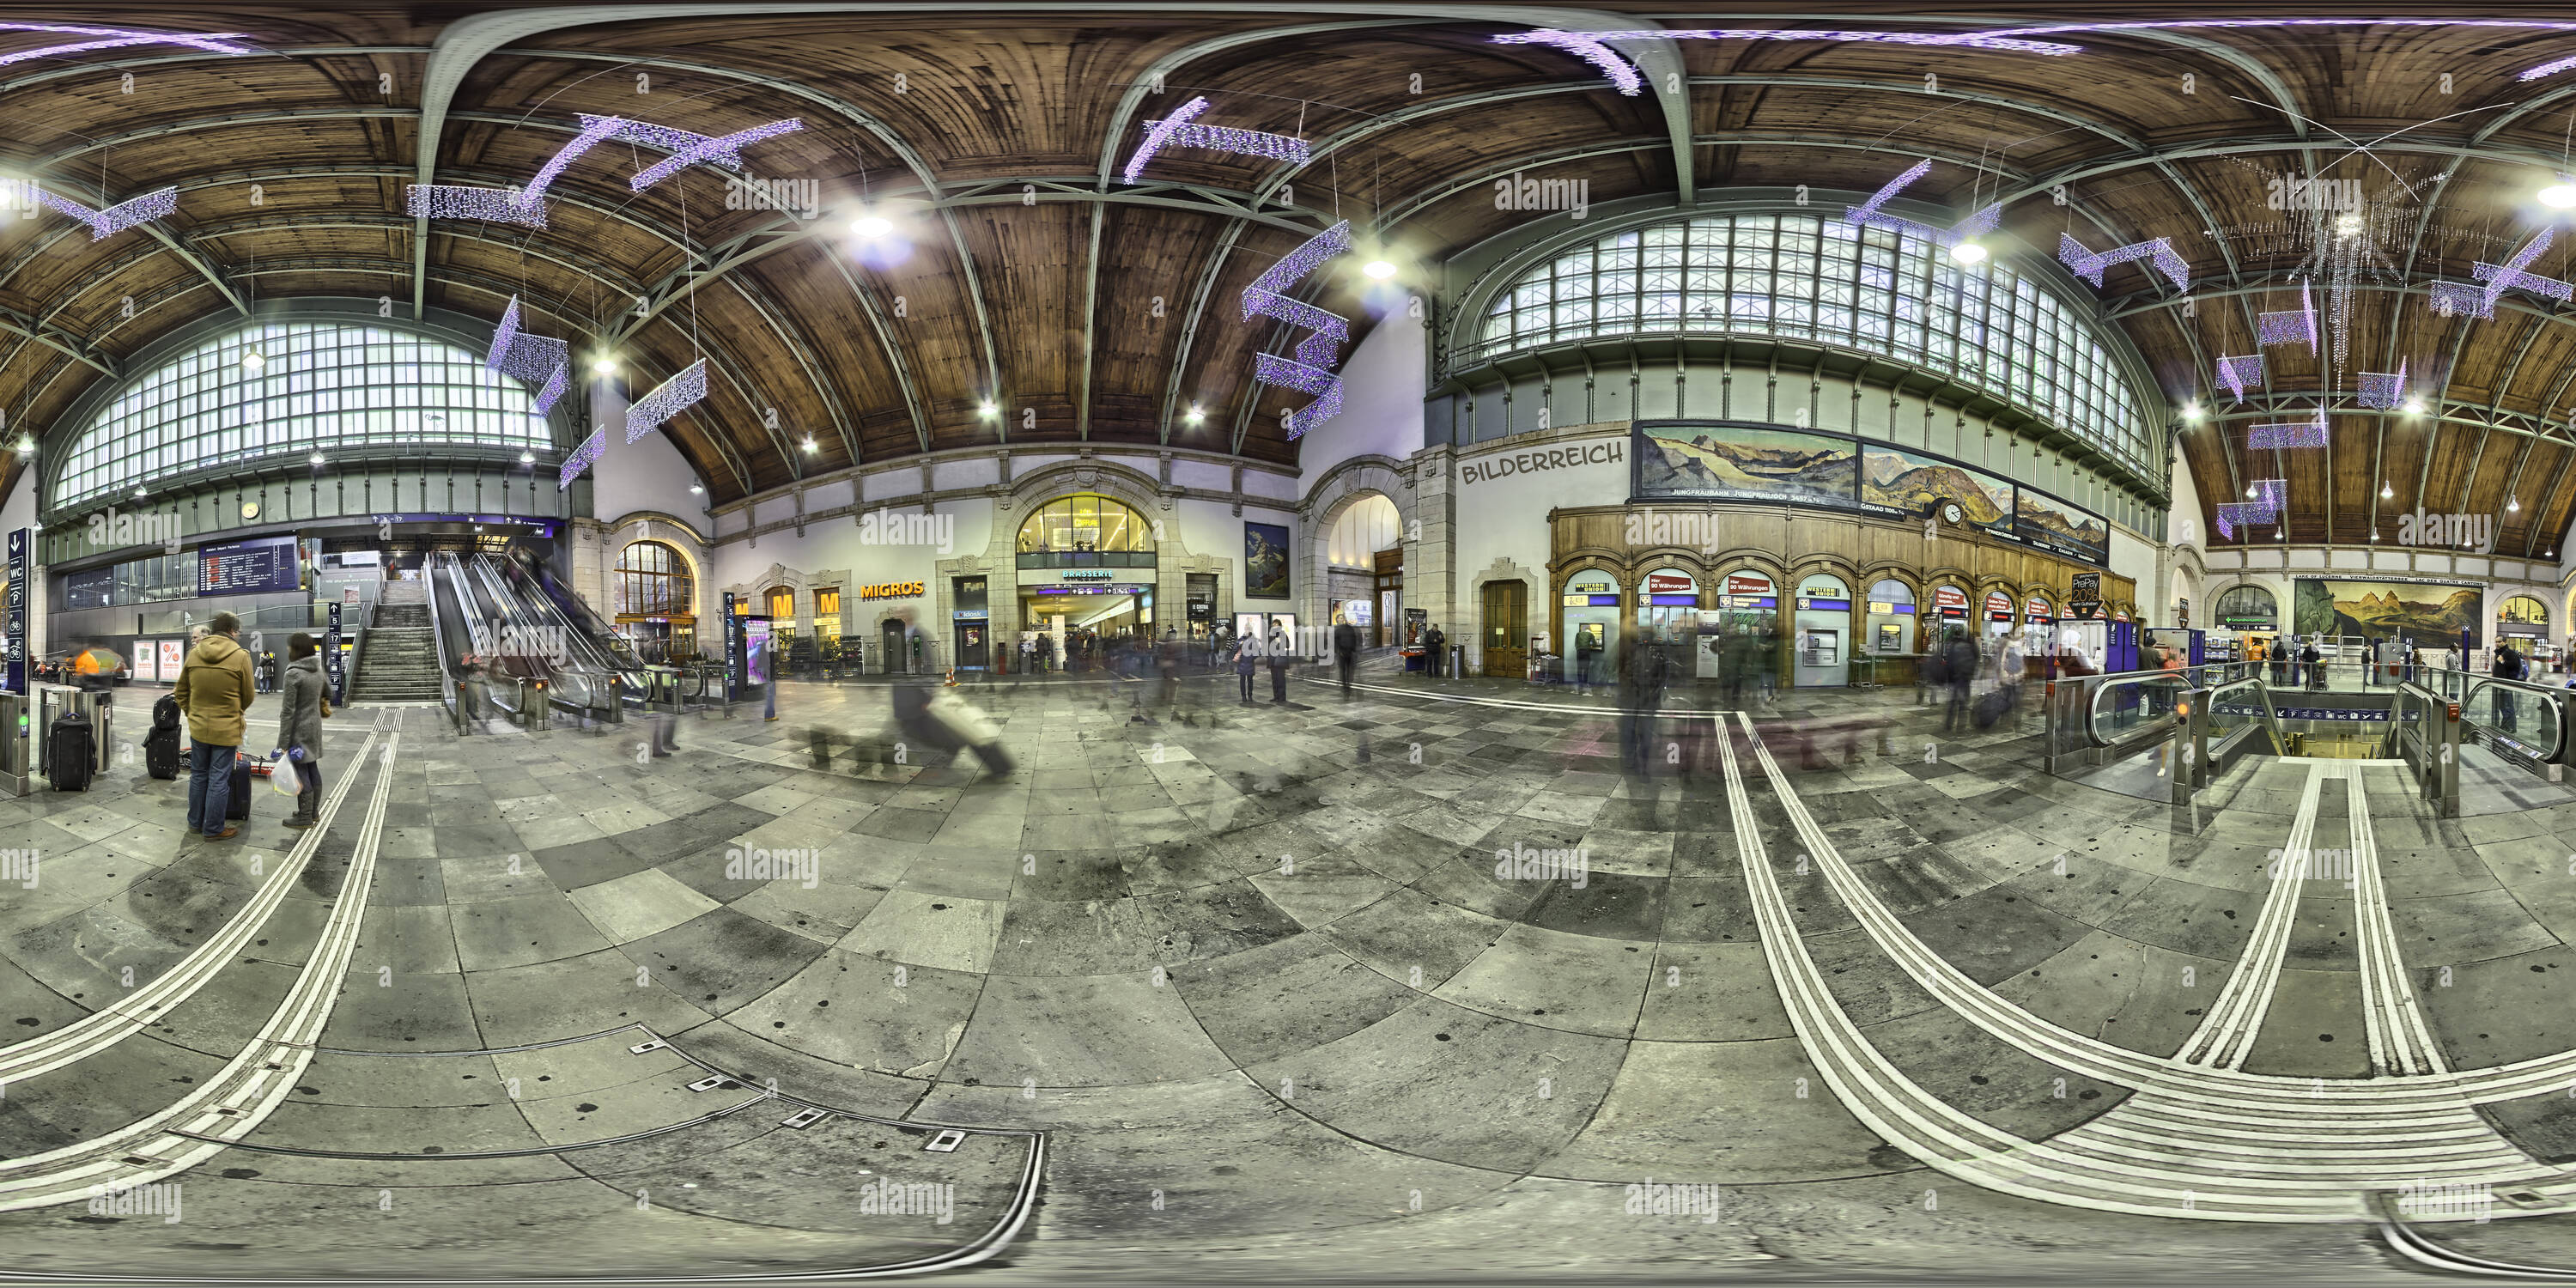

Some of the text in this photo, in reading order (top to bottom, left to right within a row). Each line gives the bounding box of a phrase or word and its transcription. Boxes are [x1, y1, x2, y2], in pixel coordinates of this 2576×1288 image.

[1461, 441, 1623, 485] BILDERREICH
[1733, 490, 1786, 500] JUNGFRAUJOCH
[1861, 503, 1884, 512] GSTAAD
[10, 568, 22, 579] WC
[860, 580, 924, 599] MIGROS
[2073, 579, 2099, 589] PrePay
[14, 593, 19, 604] P
[2073, 589, 2098, 602] 20%
[773, 594, 793, 617] M
[821, 592, 840, 613] M
[735, 603, 749, 615] M
